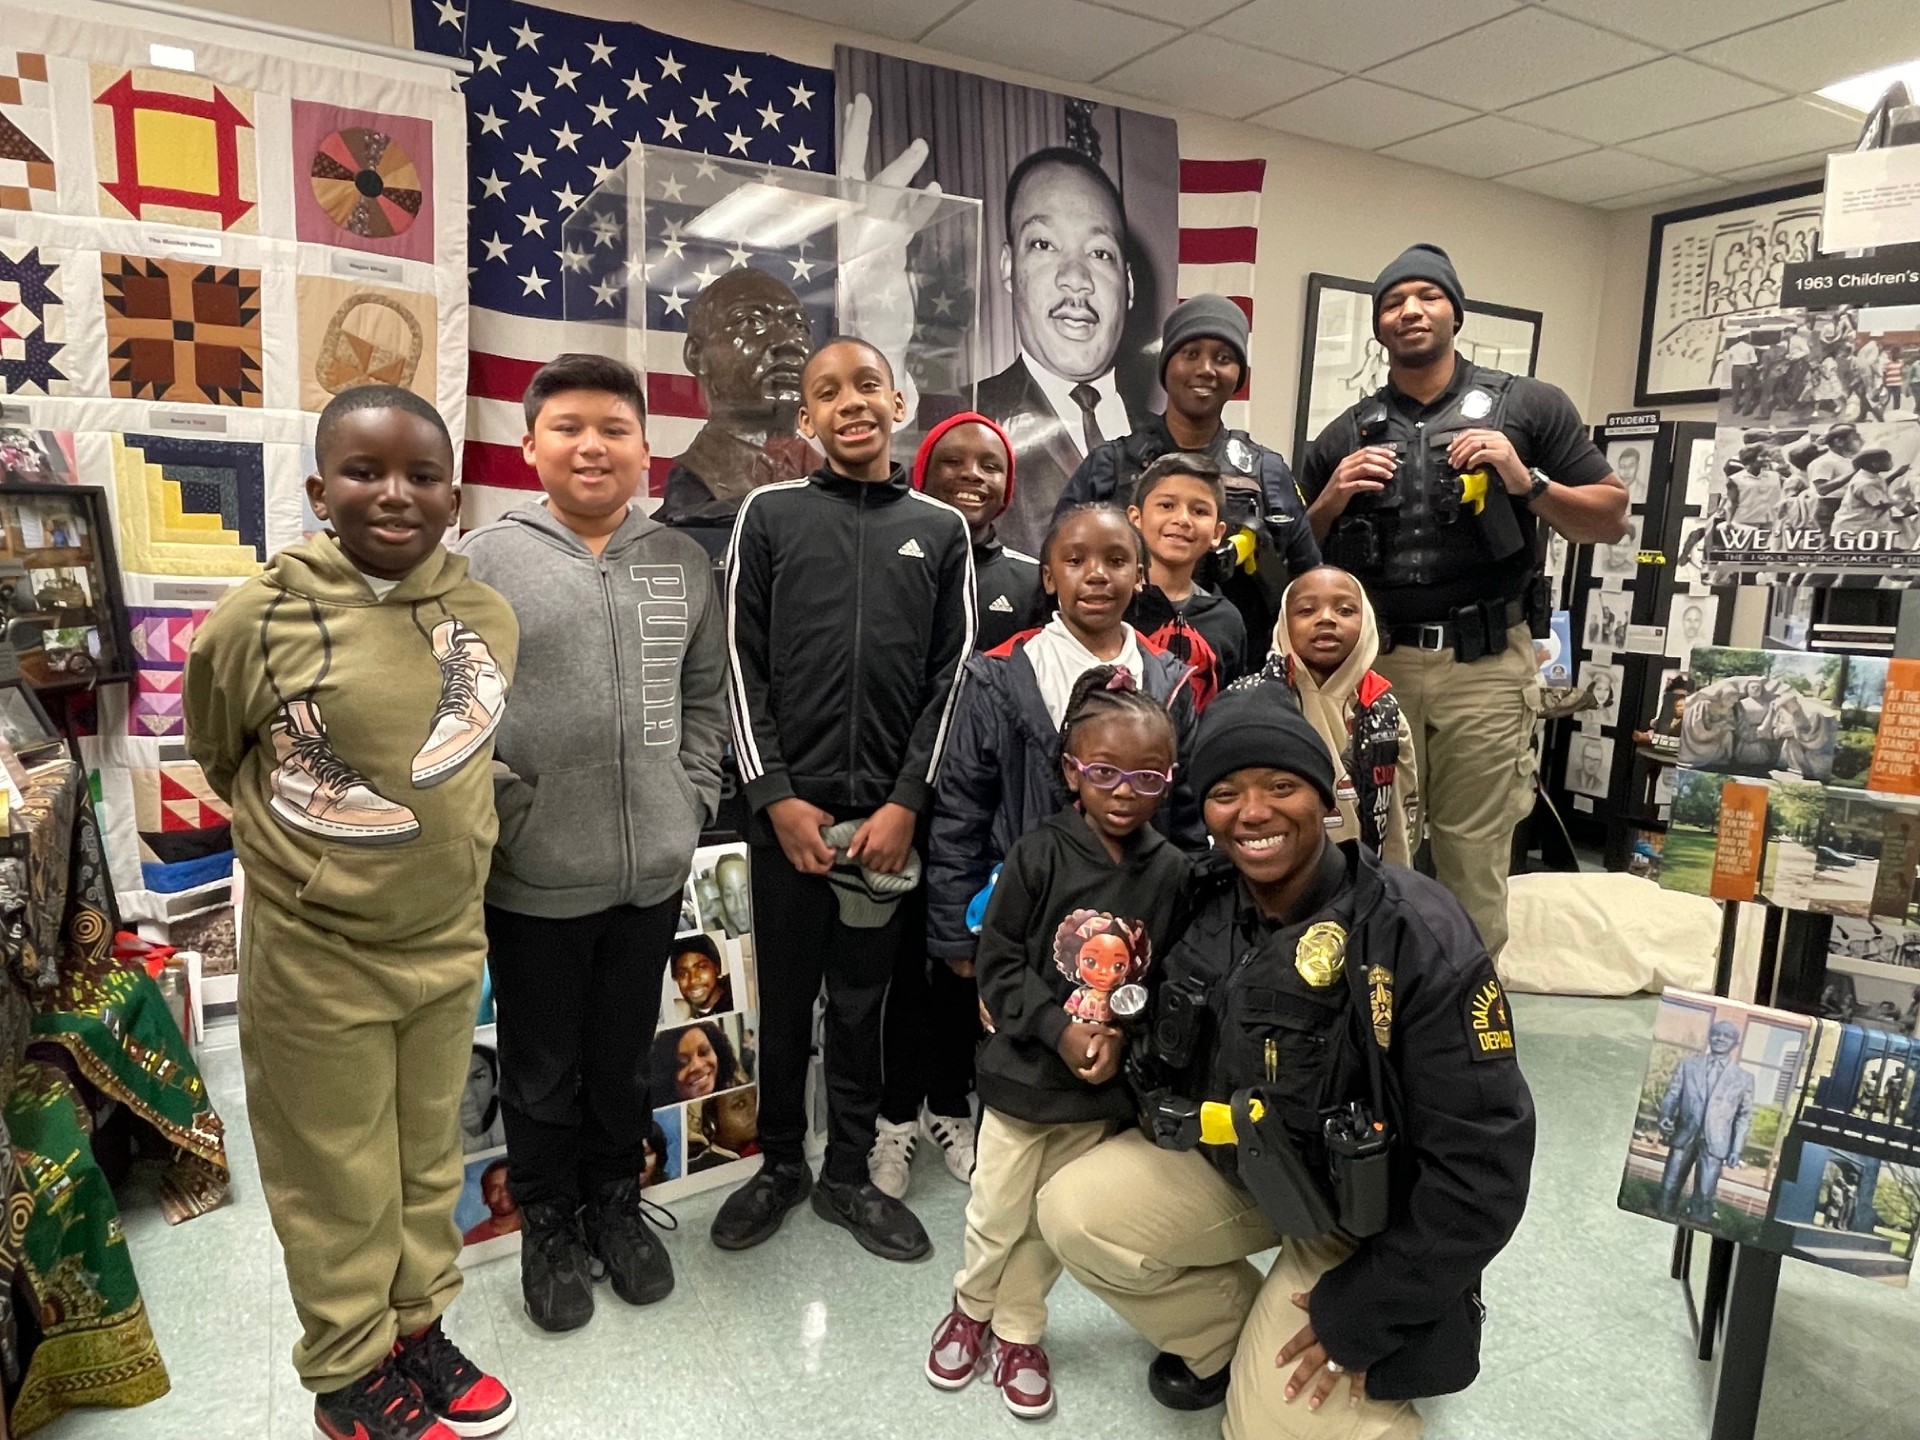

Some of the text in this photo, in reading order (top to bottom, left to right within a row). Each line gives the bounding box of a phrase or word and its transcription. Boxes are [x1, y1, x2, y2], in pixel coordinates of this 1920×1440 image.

[1795, 270, 1919, 290] 1963 Children's
[1609, 414, 1657, 425] STUDENTS
[1834, 530, 1900, 551] GOT
[1724, 553, 1743, 561] THE
[1786, 554, 1872, 563] BIRMINGHAM
[629, 564, 688, 745] PUMA
[1880, 737, 1916, 751] STANDS
[1874, 761, 1888, 773] OF
[1471, 980, 1498, 1029] DALLAS
